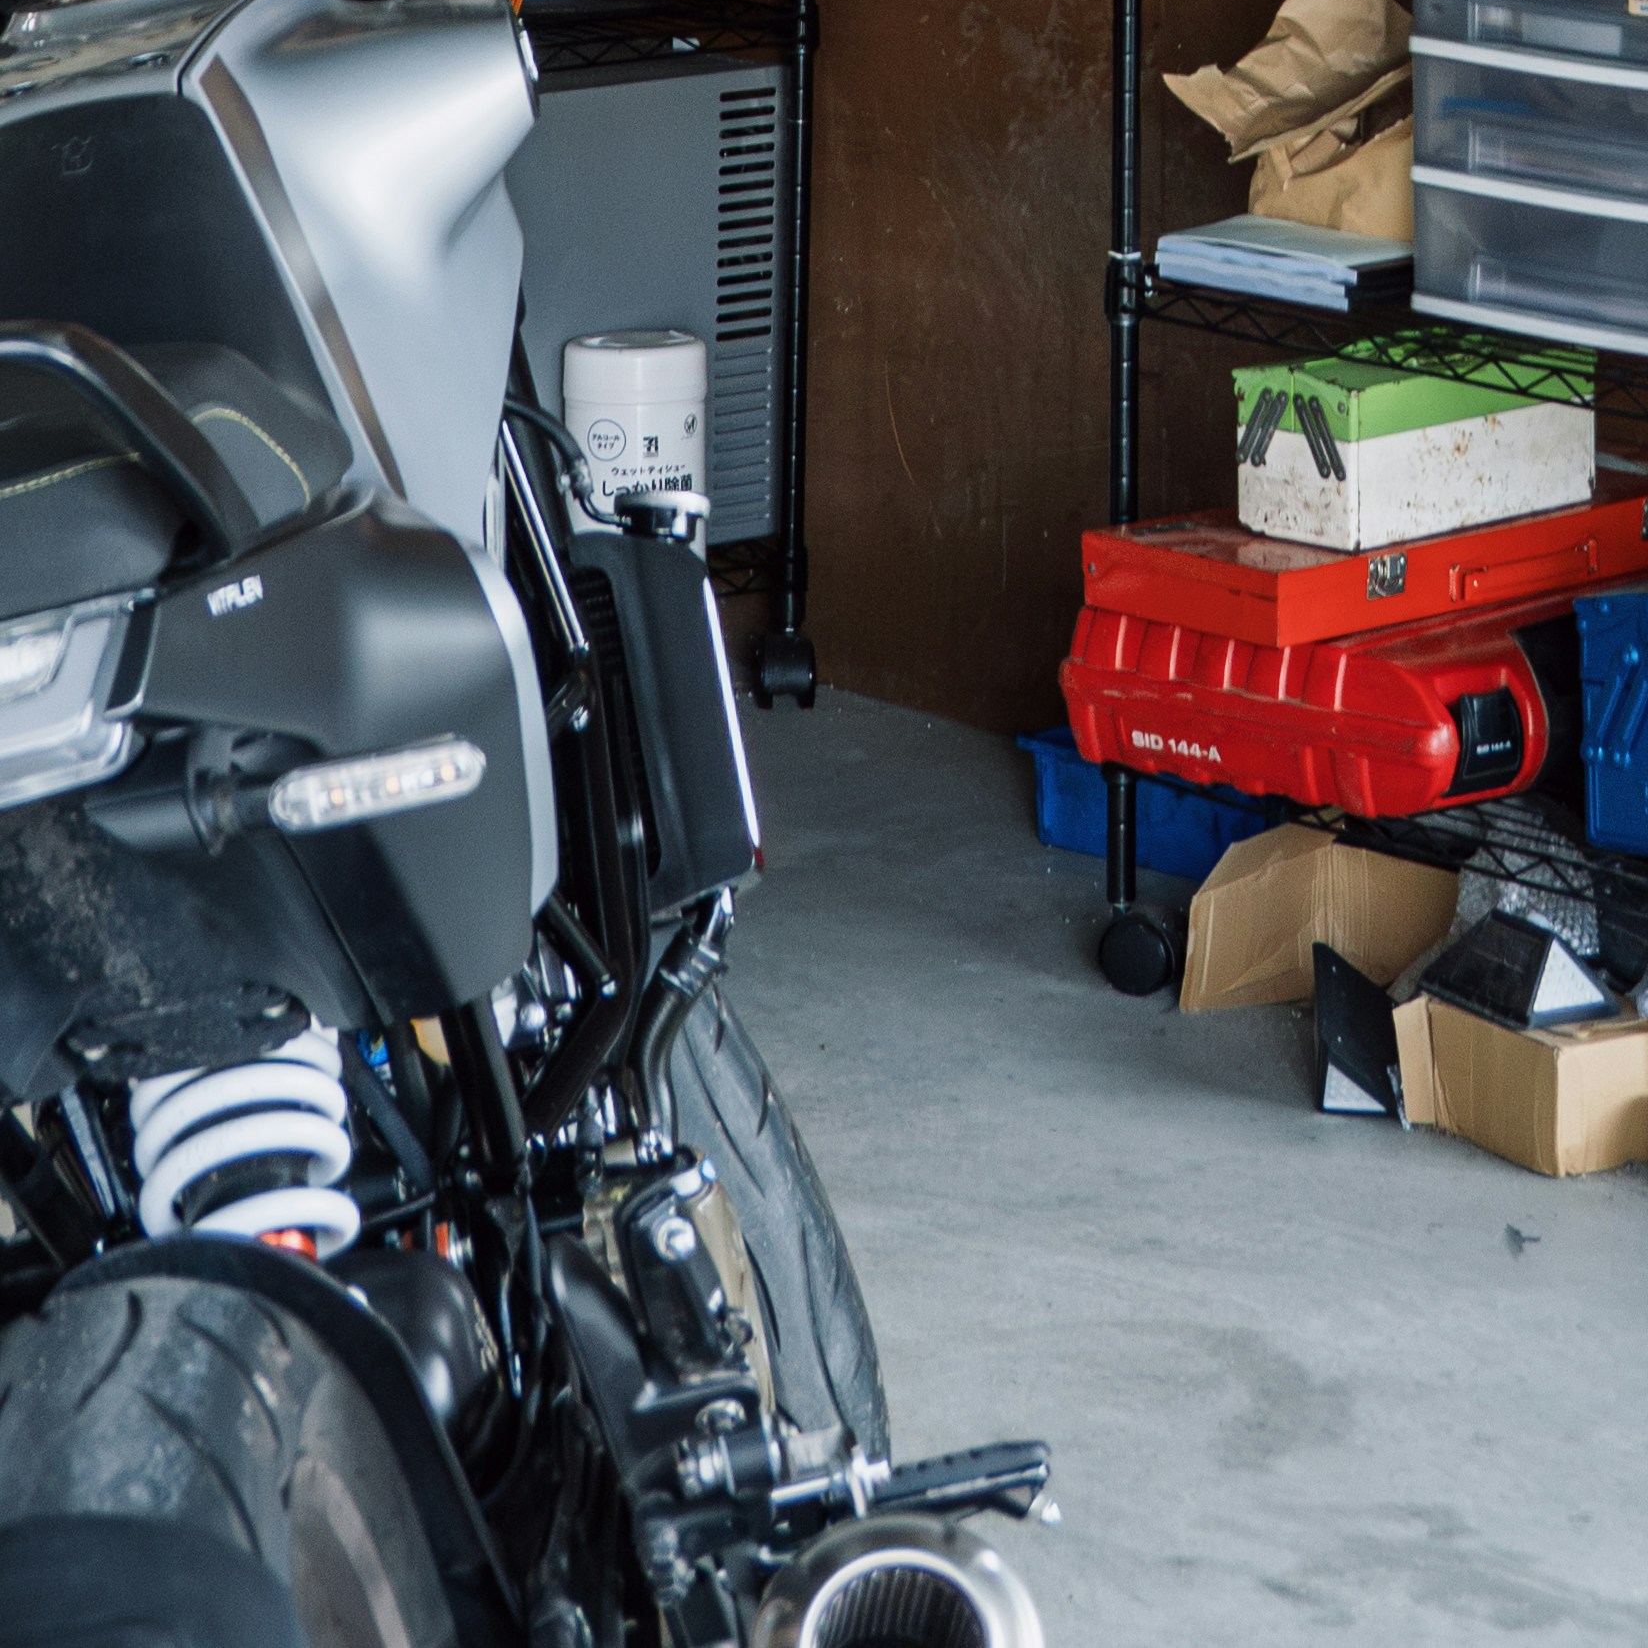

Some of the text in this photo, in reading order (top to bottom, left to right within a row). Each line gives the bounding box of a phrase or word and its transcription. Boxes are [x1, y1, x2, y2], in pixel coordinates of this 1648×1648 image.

[602, 473, 693, 497] しっかり除菌
[1168, 738, 1222, 763] 144-A
